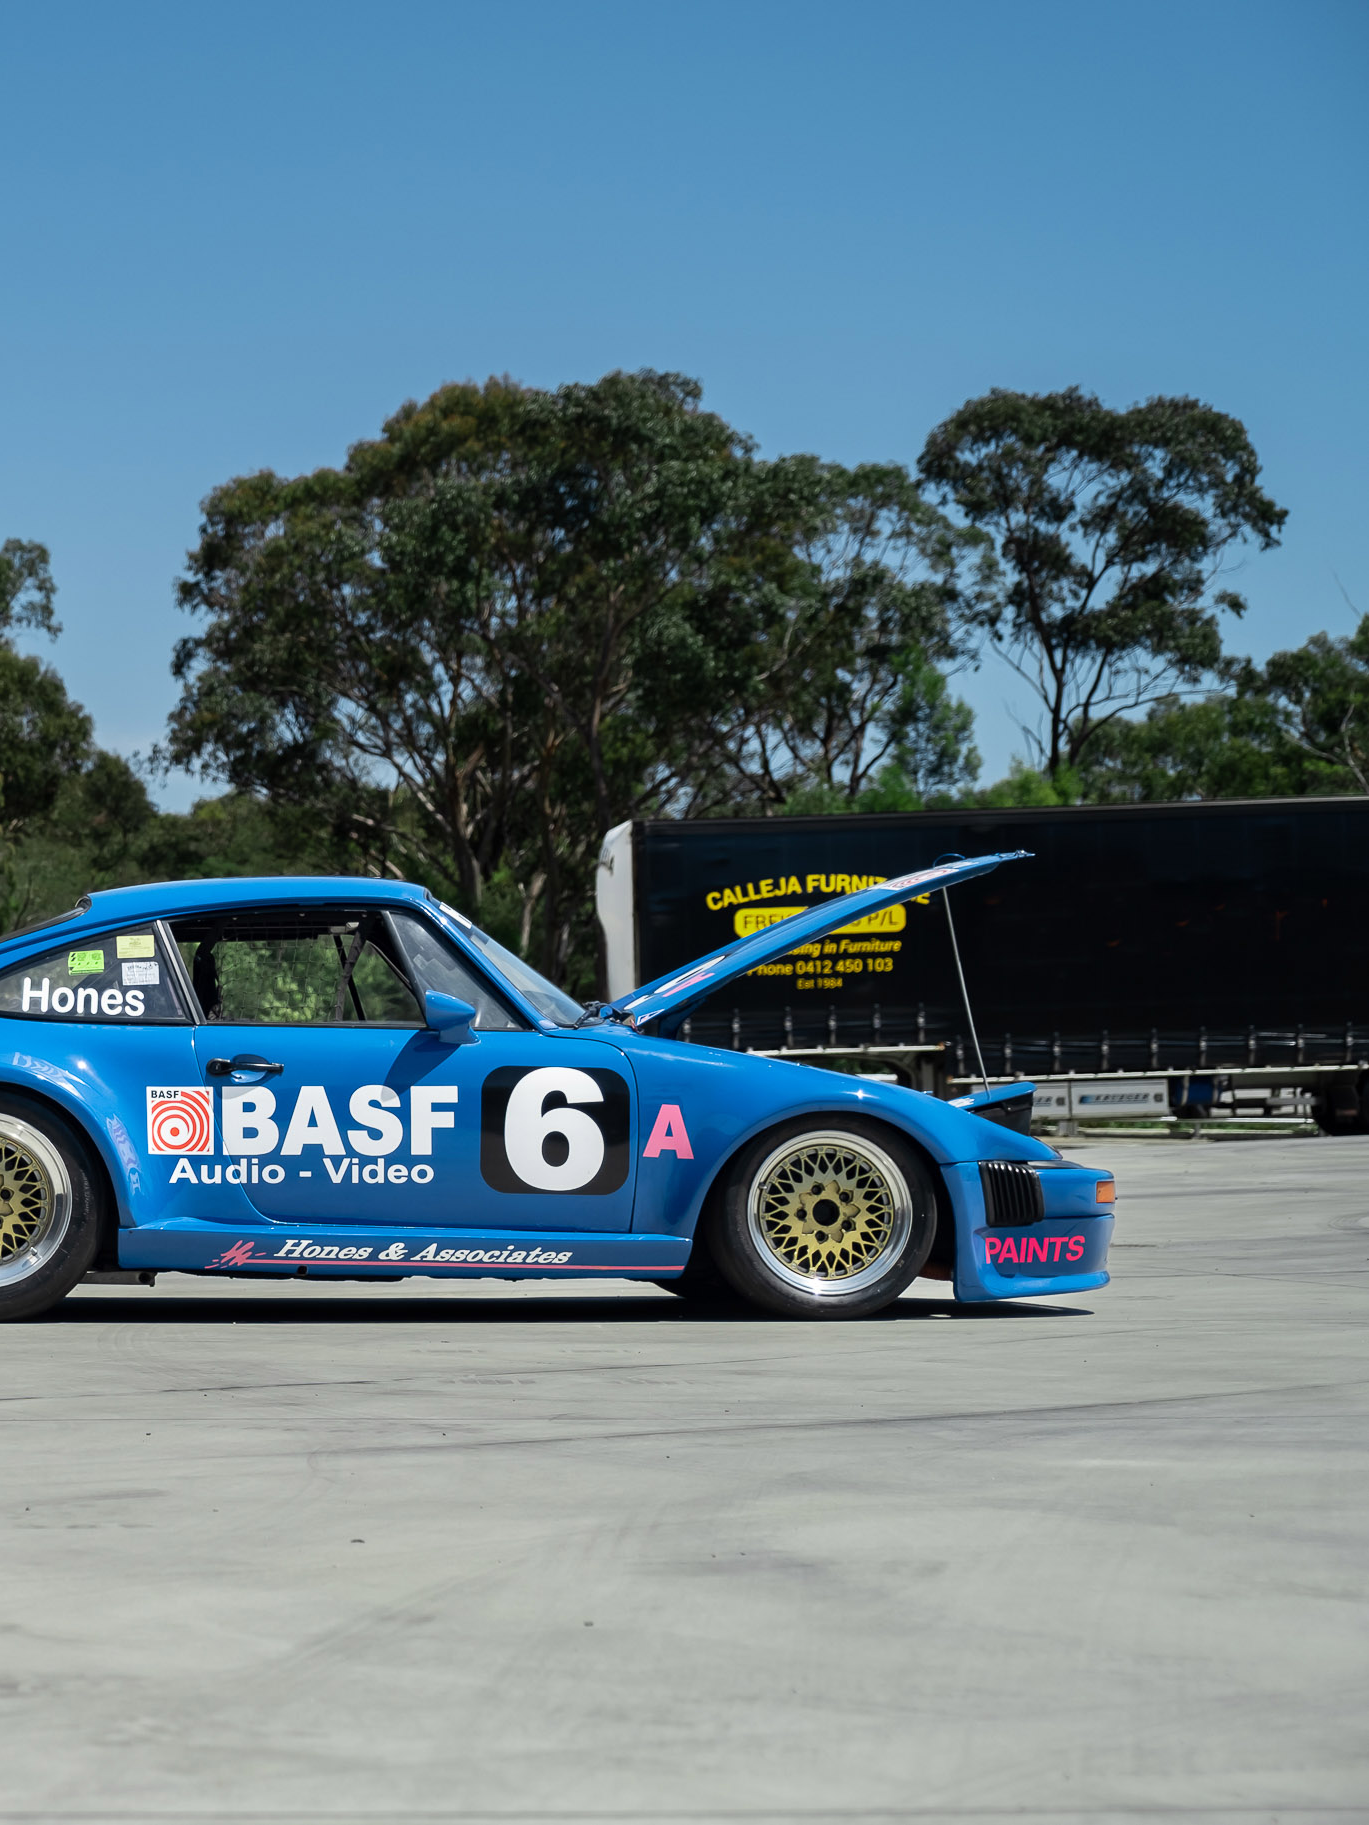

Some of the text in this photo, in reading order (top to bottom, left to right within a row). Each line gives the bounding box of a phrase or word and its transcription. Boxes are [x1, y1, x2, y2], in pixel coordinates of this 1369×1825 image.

[705, 876, 802, 911] CALLEJA
[822, 939, 837, 954] in
[838, 938, 902, 954] Furniture
[795, 959, 833, 975] 0412
[835, 958, 863, 974] 450
[866, 957, 894, 973] 103
[21, 976, 146, 1017] Hones
[150, 1090, 180, 1099] BASF
[221, 1085, 458, 1156] BASF
[504, 1066, 604, 1192] 6
[642, 1104, 694, 1160] A
[168, 1157, 435, 1185] Audio - Video
[273, 1239, 573, 1264] Hones & Associates
[984, 1235, 1086, 1265] PAINTS
